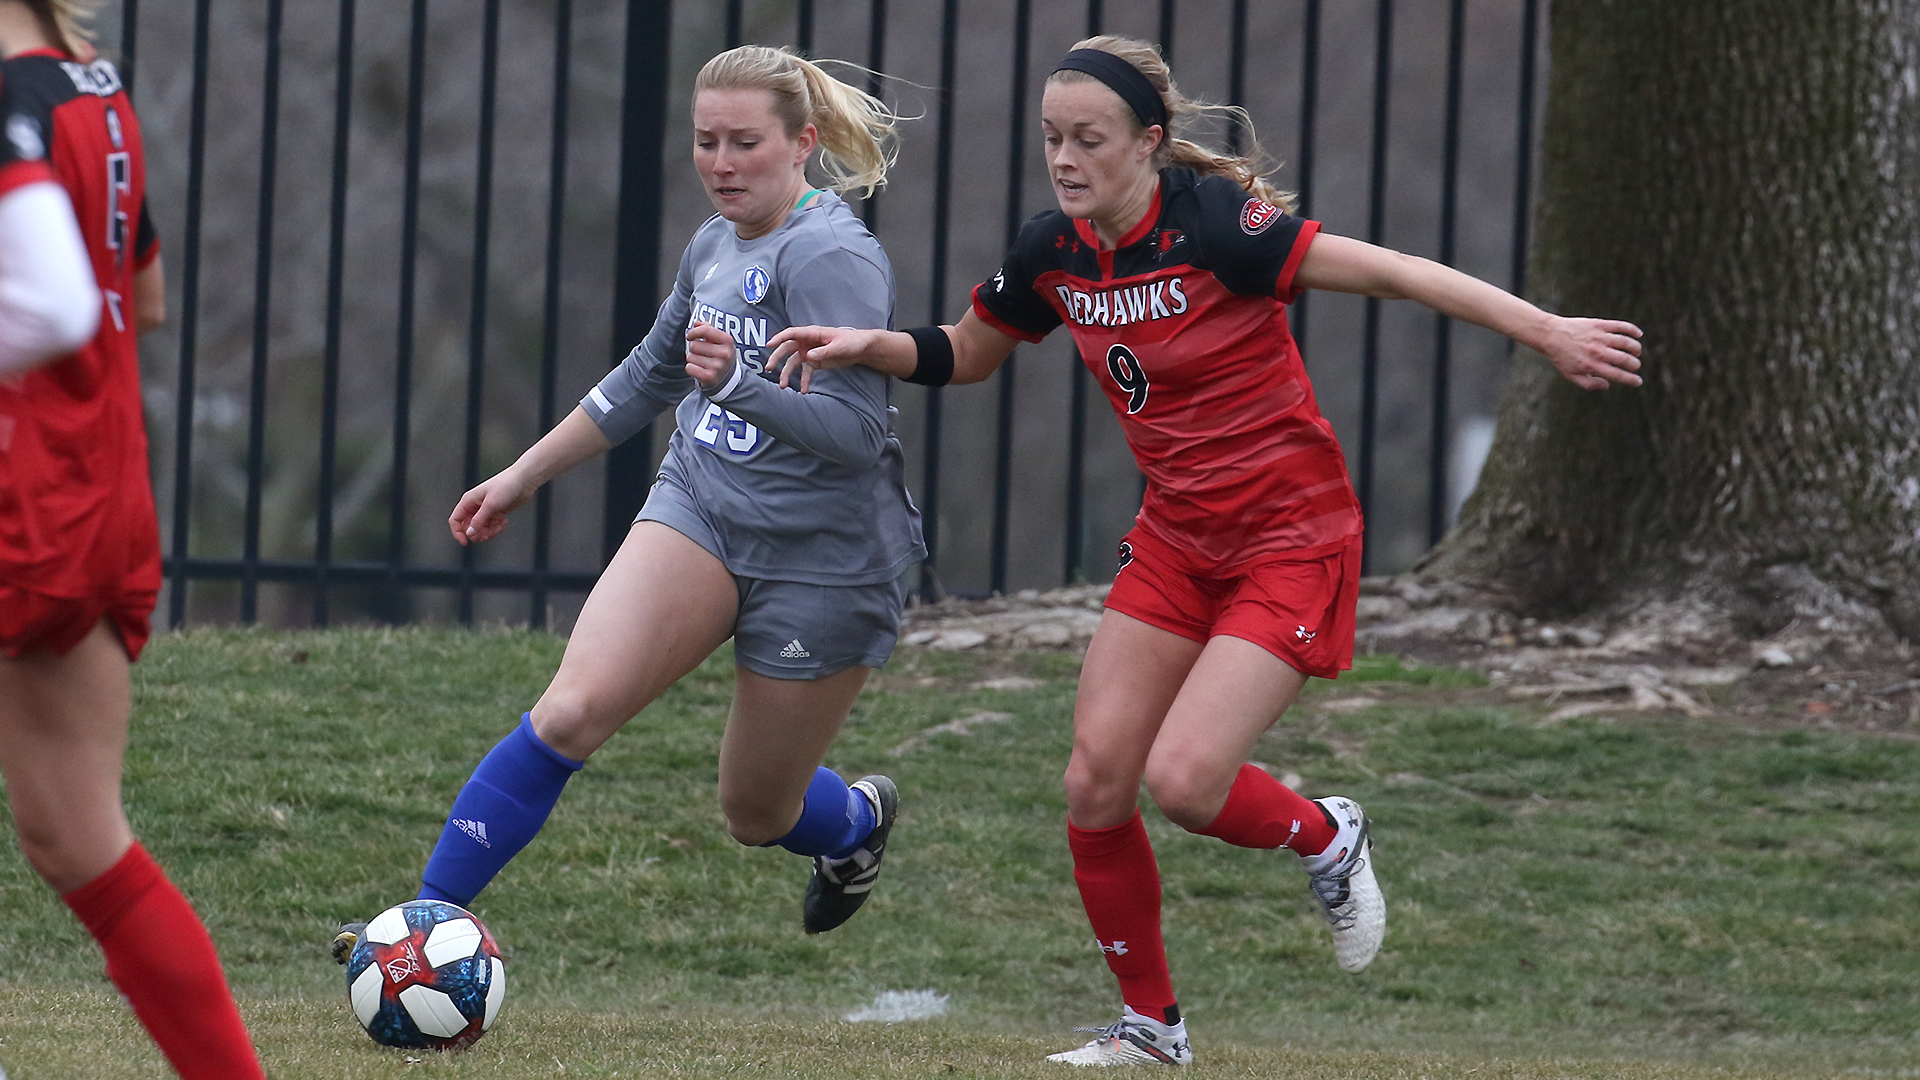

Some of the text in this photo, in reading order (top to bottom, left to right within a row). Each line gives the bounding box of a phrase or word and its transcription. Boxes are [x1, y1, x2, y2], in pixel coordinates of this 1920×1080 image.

[687, 300, 767, 348] ASTERN
[1055, 277, 1188, 327] REDHAWKS
[1107, 344, 1150, 414] 9
[780, 650, 811, 659] adidas
[452, 818, 492, 849] adidas
